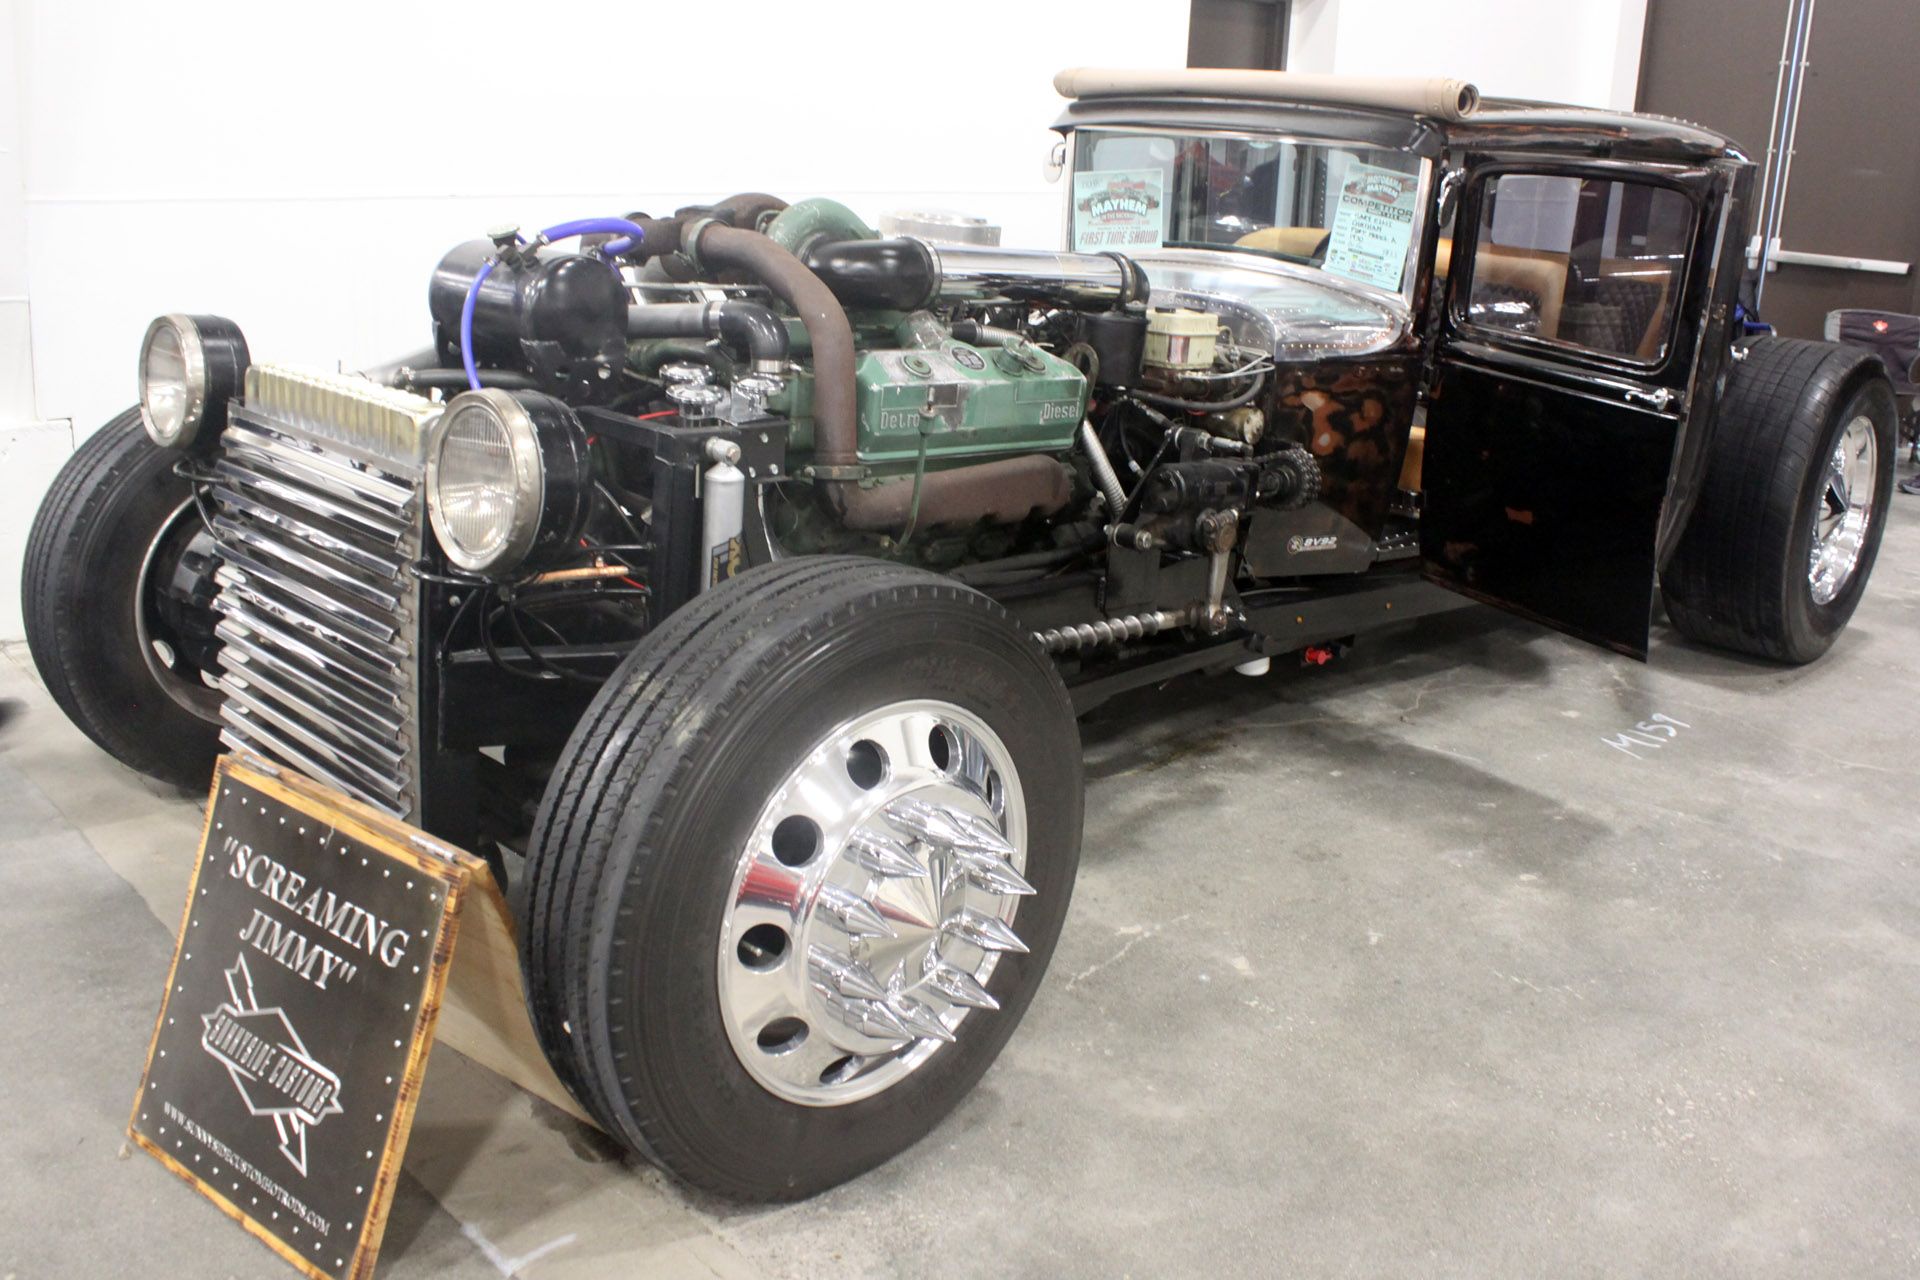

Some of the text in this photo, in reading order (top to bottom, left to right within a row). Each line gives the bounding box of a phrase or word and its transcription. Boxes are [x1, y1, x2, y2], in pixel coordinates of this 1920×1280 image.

[1091, 198, 1147, 217] MAYHEM
[1342, 195, 1413, 217] COMPETITOR
[1080, 231, 1105, 245] FIRST
[1106, 231, 1127, 244] TIME
[880, 411, 920, 430] Detro
[1043, 402, 1080, 419] Diesel
[224, 836, 410, 968] "SCREAMING
[239, 908, 358, 990] JIMMY"
[209, 1014, 332, 1113] SUNNYSIDE CUSTOMS
